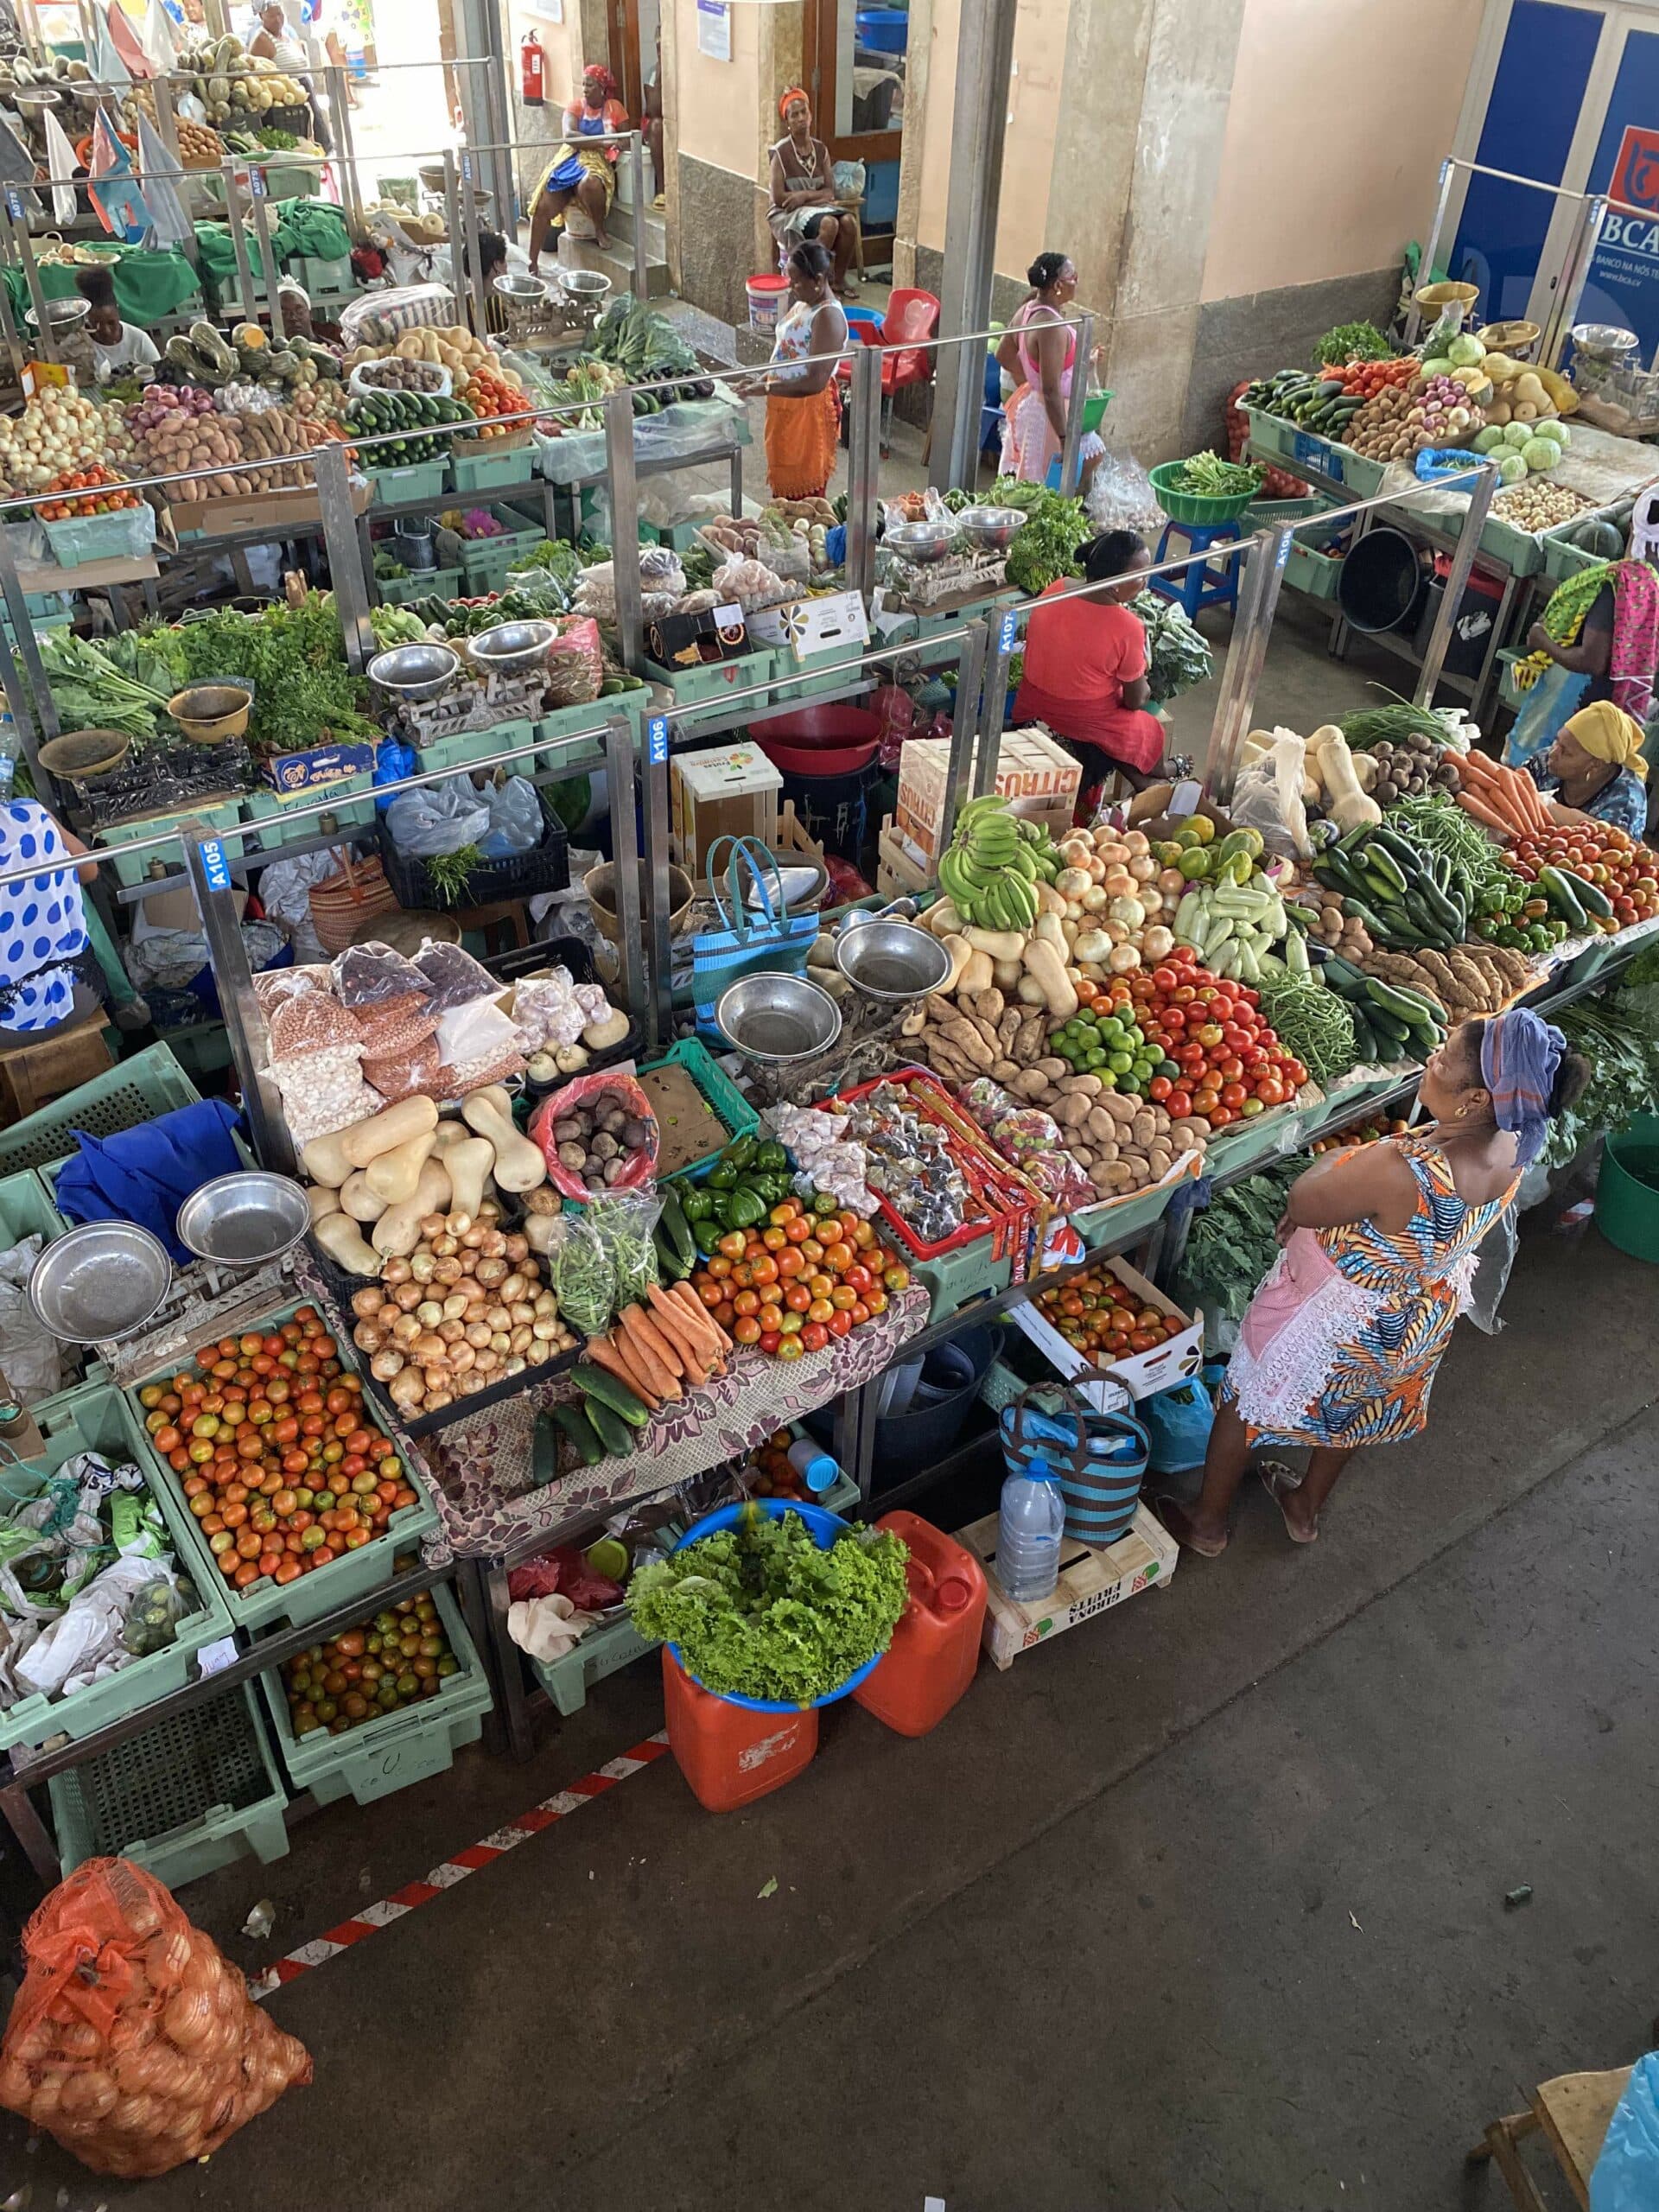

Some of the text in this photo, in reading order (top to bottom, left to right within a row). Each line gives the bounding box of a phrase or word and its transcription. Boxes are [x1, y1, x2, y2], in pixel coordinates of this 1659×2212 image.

[251, 169, 261, 194] A079
[1600, 213, 1659, 254] BCA
[1278, 530, 1292, 565] A108
[1001, 614, 1014, 651] A107
[652, 721, 666, 760] A106
[995, 769, 1079, 798] CITRUS
[899, 782, 936, 827] CITRUS
[203, 842, 226, 884] A105
[1069, 1581, 1122, 1614] FRUITS
[1069, 1592, 1121, 1624] GIRONA
